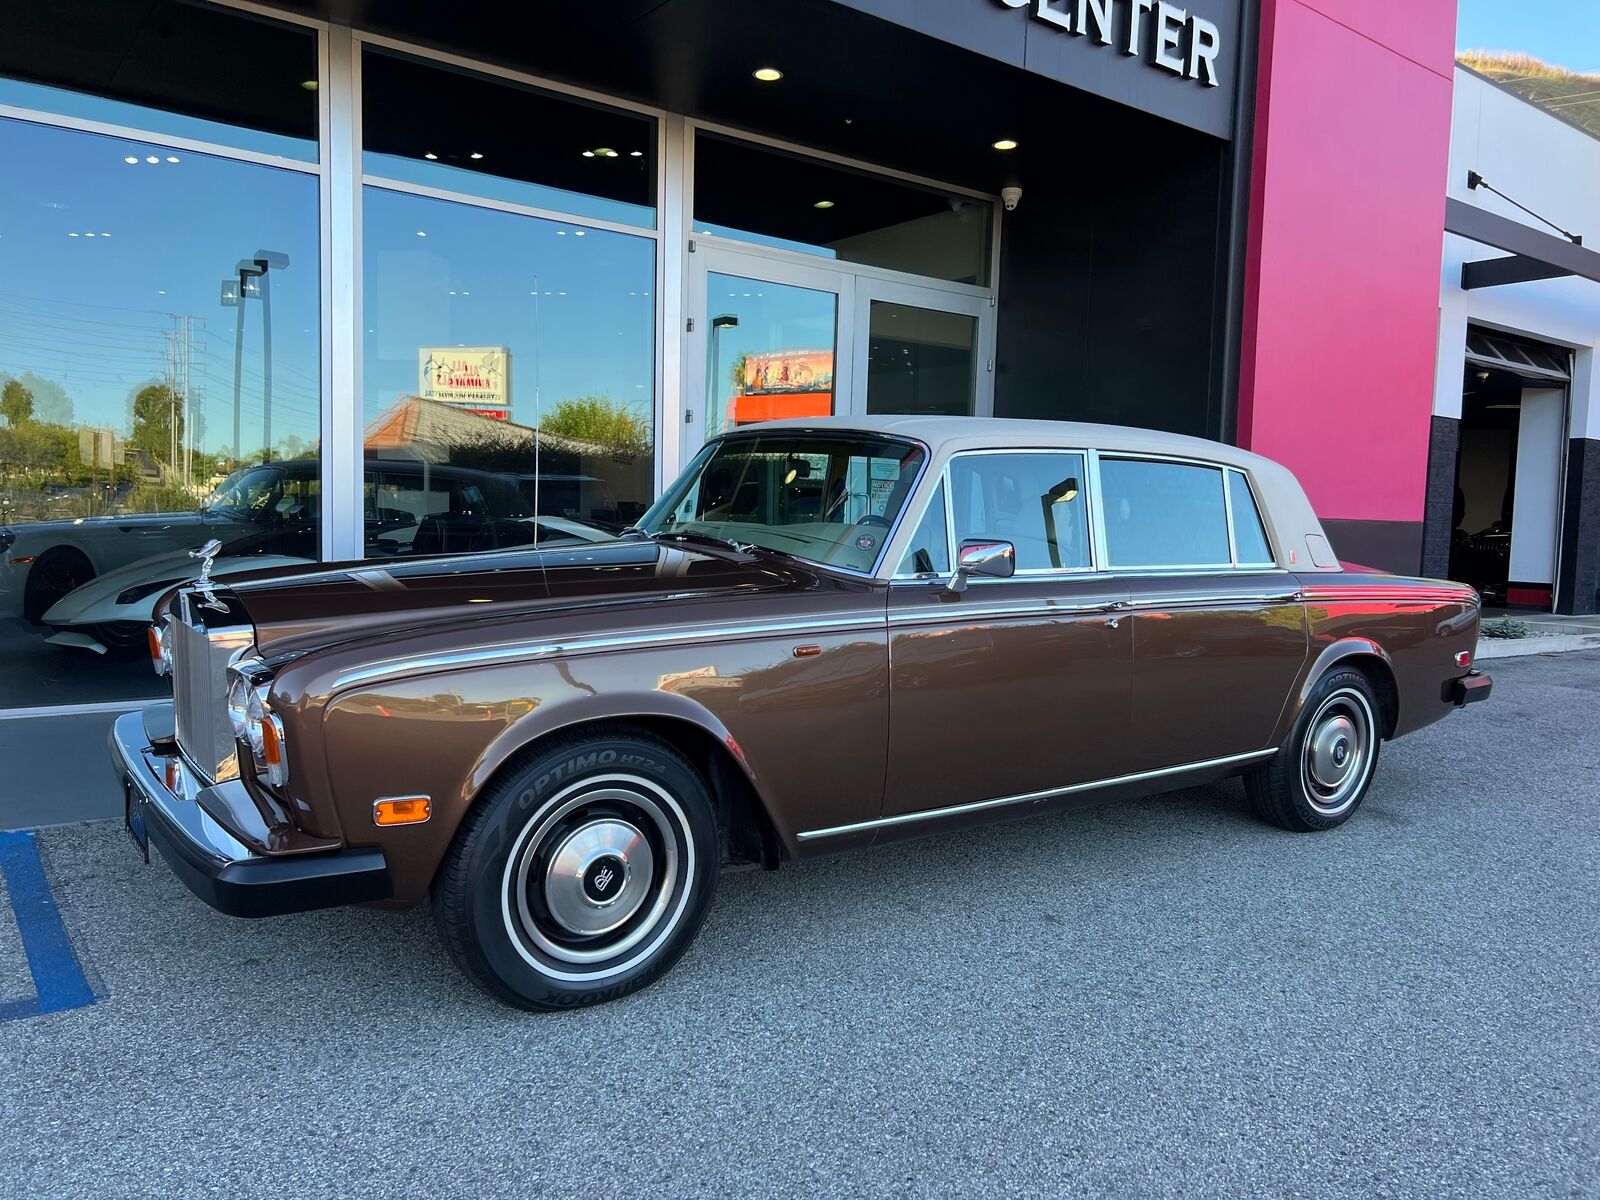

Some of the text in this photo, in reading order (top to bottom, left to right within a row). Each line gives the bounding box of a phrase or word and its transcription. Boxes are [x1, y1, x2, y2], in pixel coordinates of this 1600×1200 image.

[997, 0, 1219, 87] NTER
[518, 750, 666, 810] OPTIMO H724
